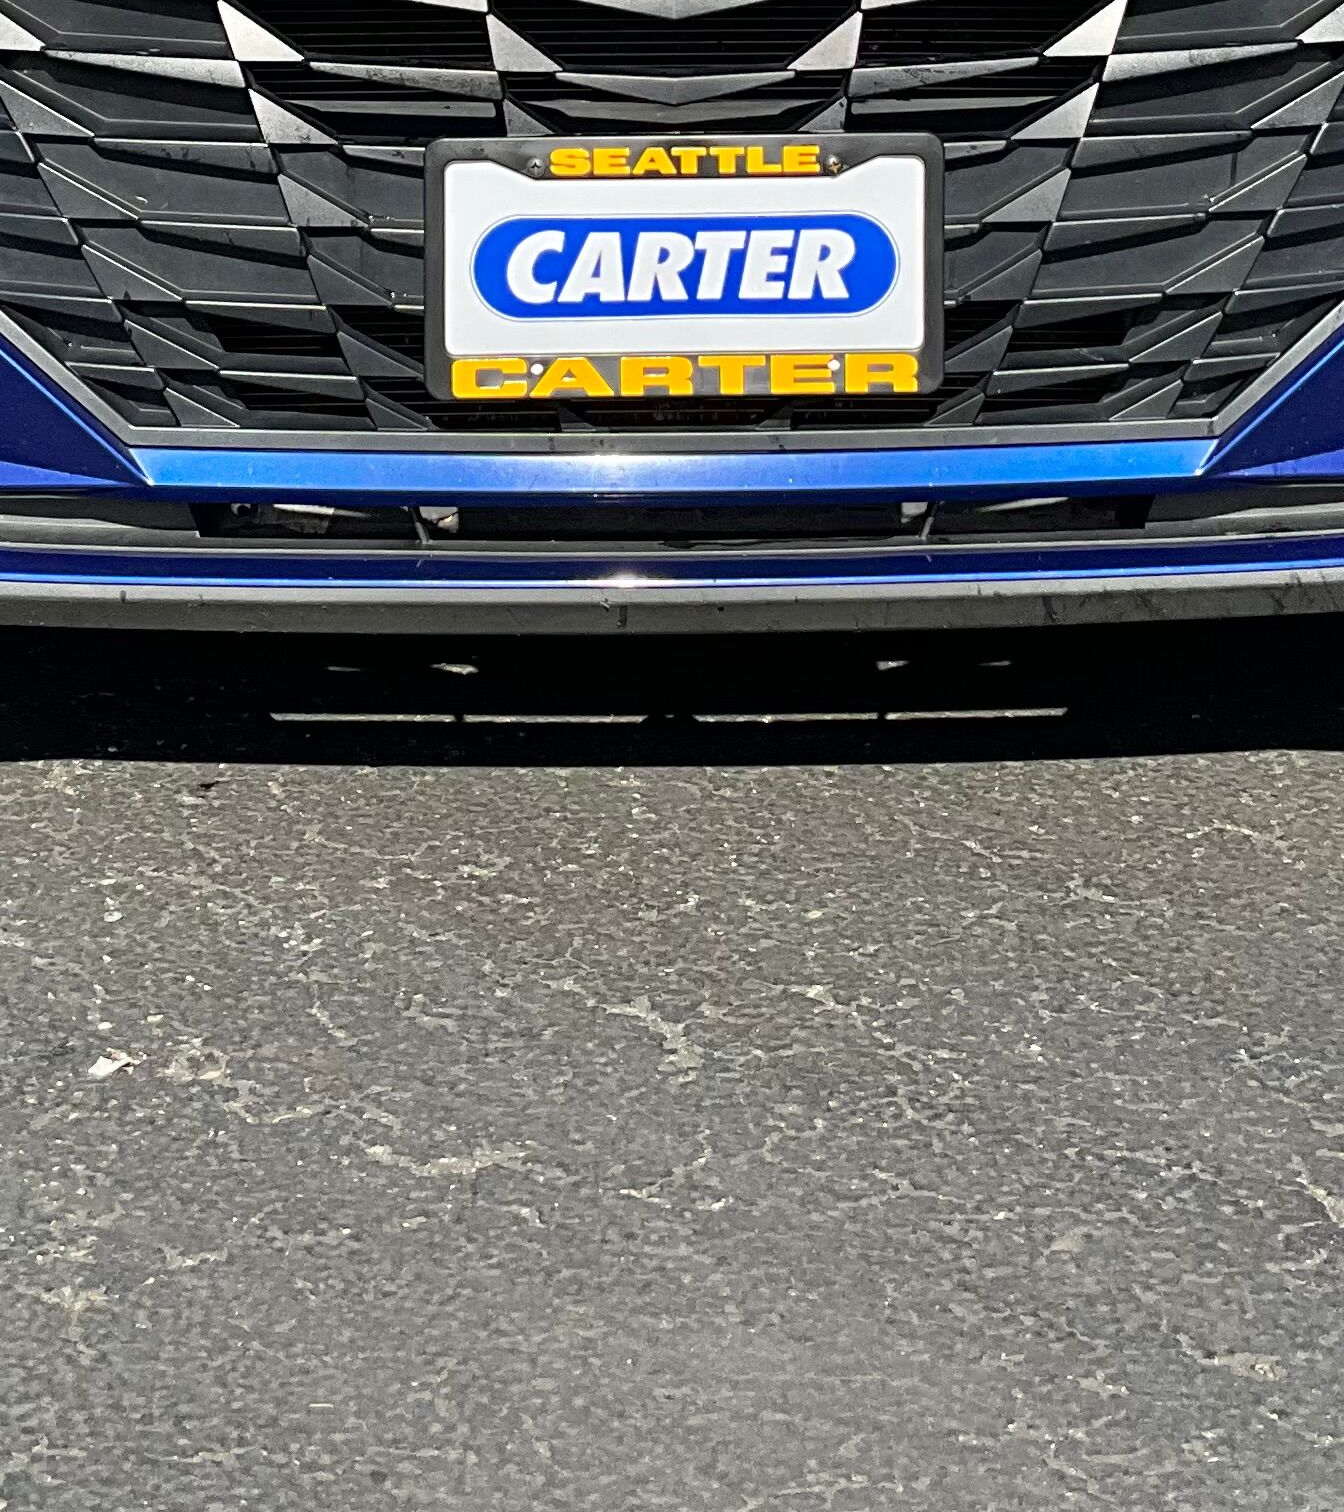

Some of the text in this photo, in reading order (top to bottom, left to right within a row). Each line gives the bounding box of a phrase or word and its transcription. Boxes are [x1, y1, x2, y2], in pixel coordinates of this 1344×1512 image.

[549, 146, 822, 177] SEATTLE
[505, 228, 857, 305] CARTER
[451, 353, 920, 399] CARTER
